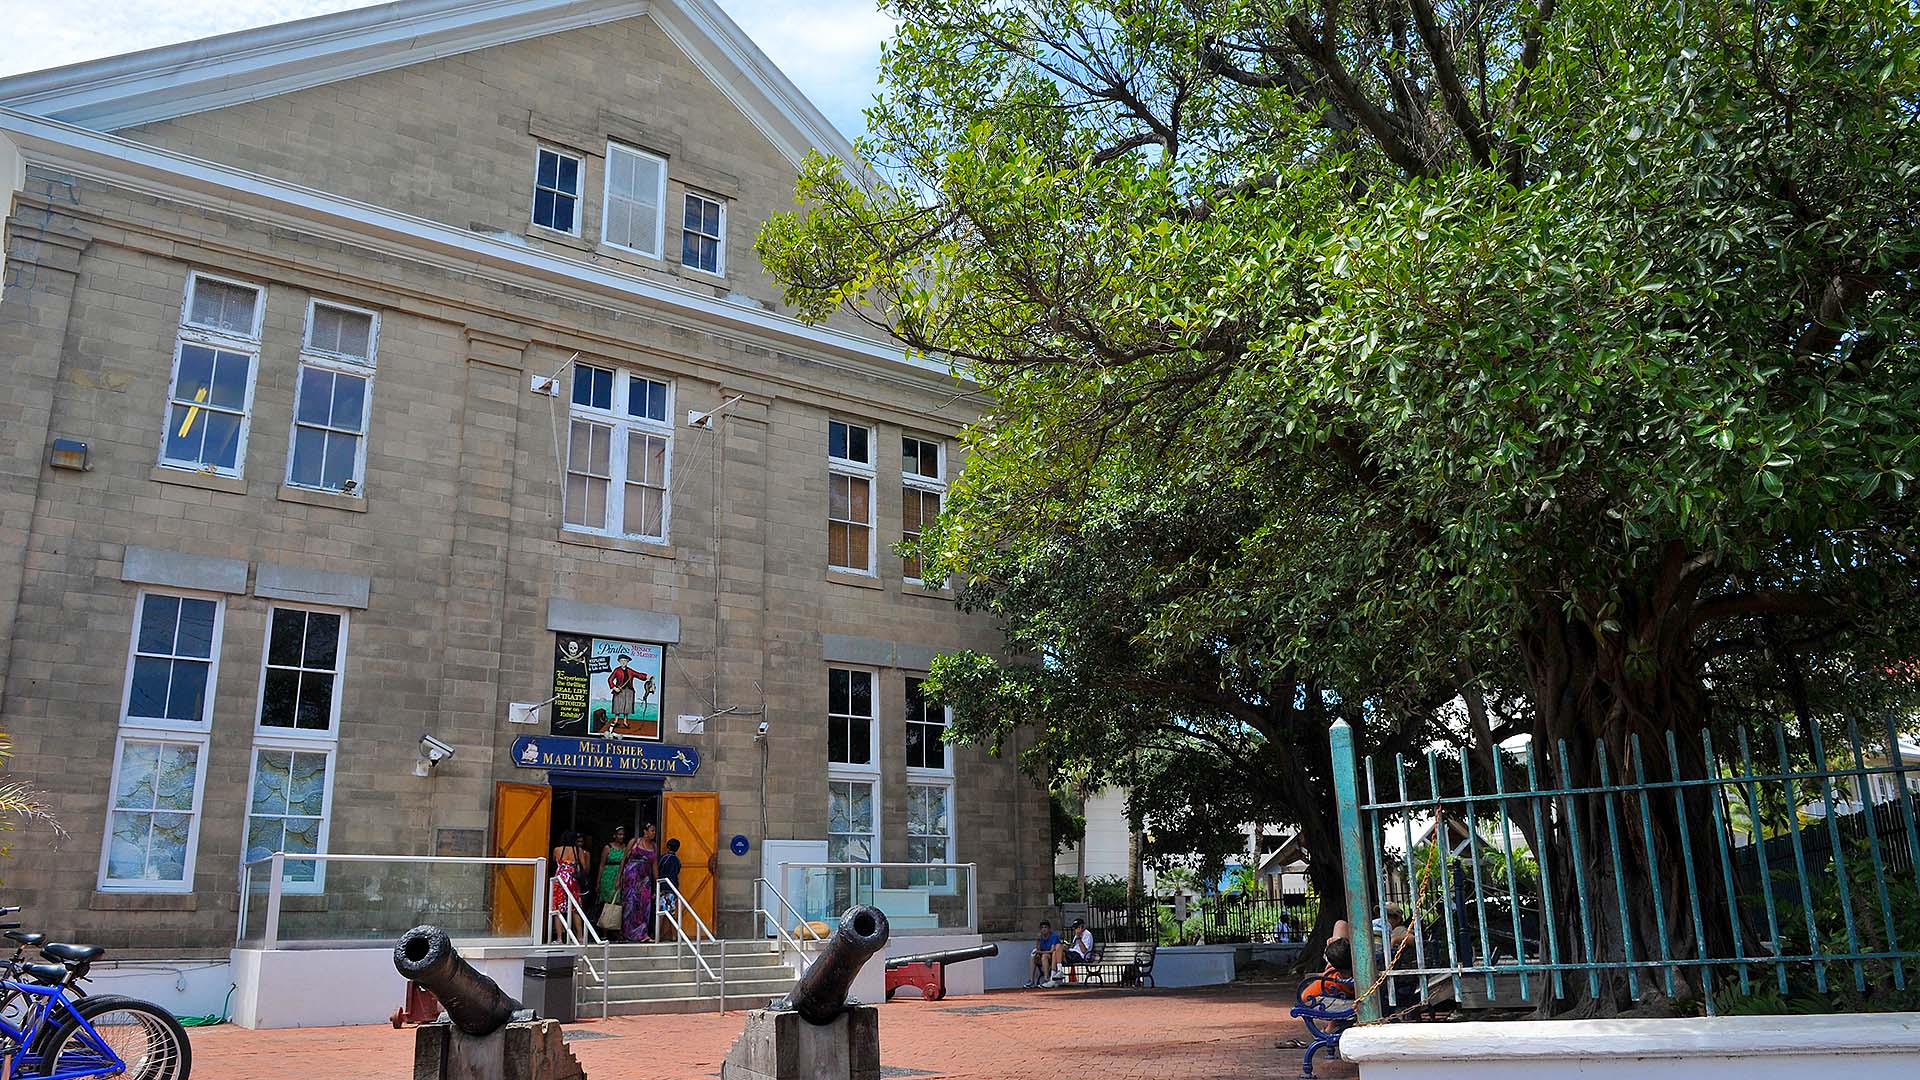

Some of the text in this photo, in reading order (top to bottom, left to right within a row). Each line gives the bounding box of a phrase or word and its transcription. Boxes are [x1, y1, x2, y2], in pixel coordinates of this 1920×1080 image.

[556, 670, 588, 682] Experience
[605, 742, 643, 756] FISHER
[543, 753, 676, 771] MARITIME MUSEUM
